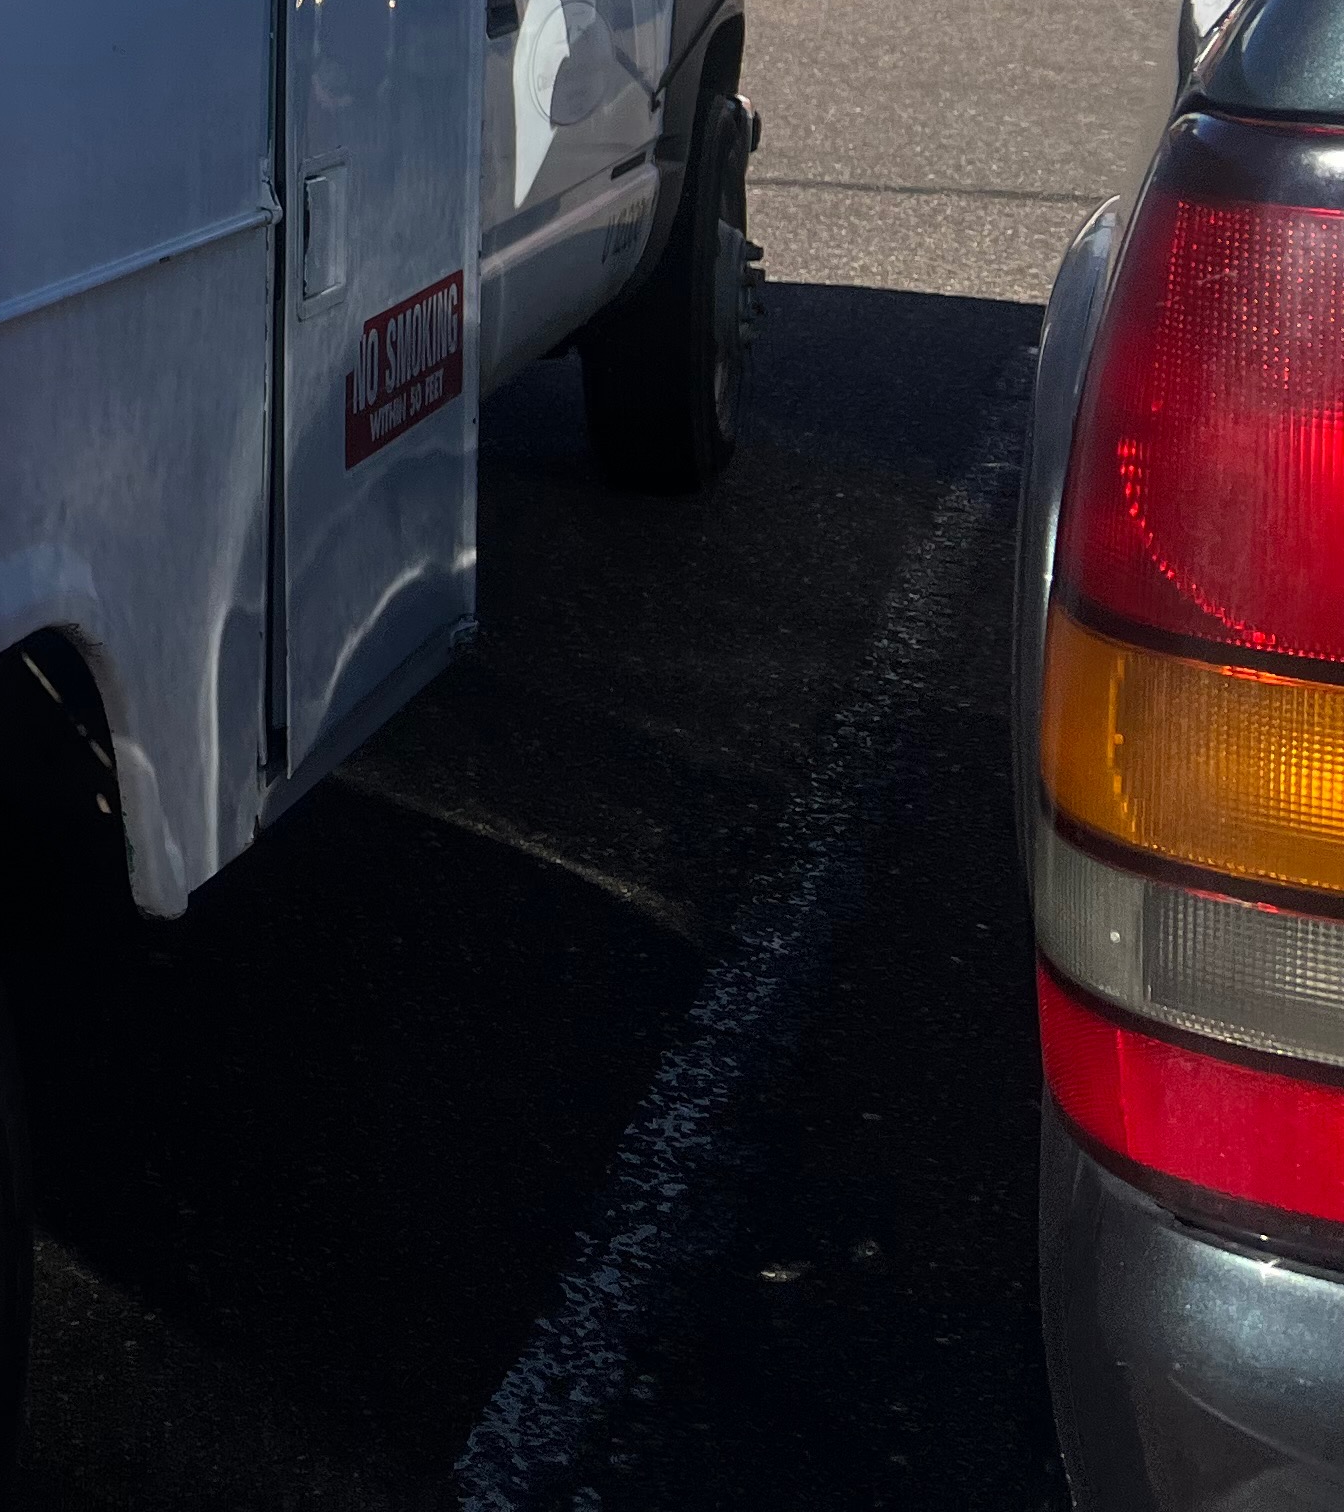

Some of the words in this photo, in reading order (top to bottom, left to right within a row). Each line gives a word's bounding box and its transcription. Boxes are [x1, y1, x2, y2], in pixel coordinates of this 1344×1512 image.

[353, 328, 379, 414] NO
[385, 283, 458, 393] SMOKING
[370, 392, 407, 442] WITHIN
[410, 382, 422, 417] 50
[425, 368, 444, 406] FEET
